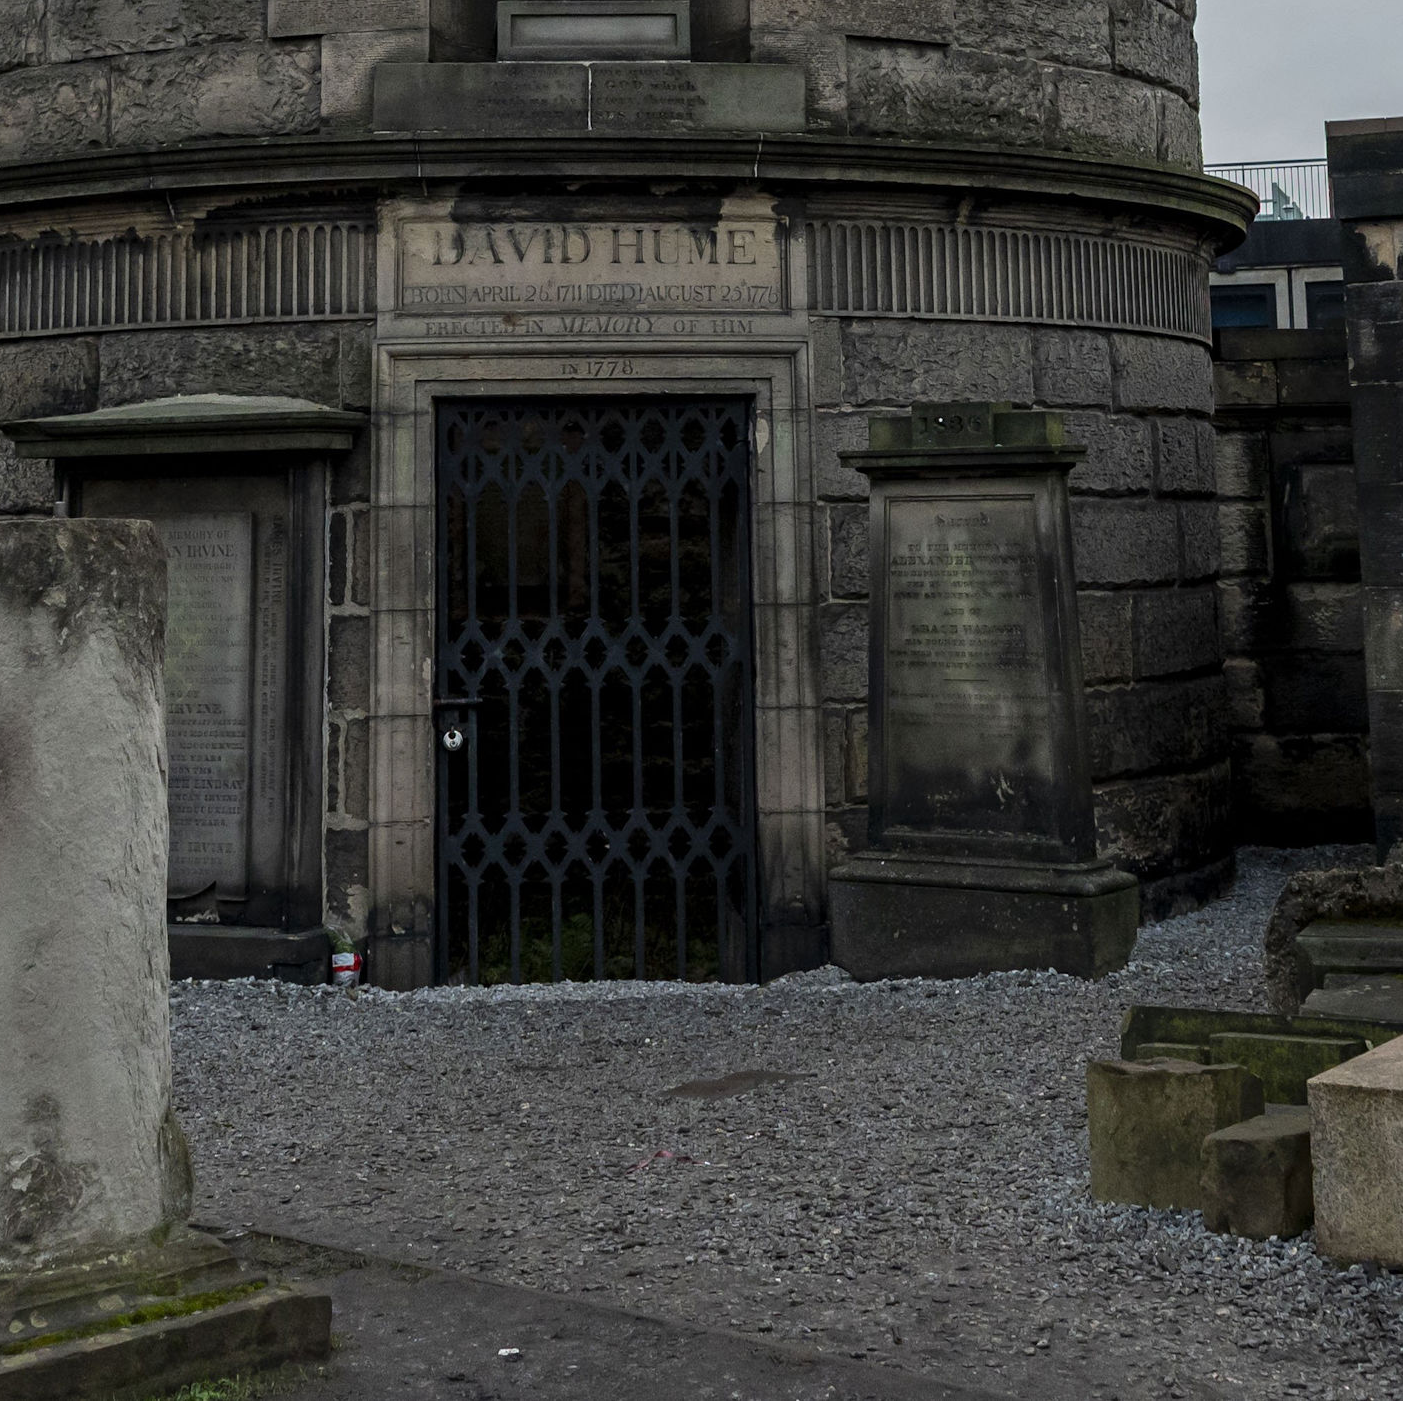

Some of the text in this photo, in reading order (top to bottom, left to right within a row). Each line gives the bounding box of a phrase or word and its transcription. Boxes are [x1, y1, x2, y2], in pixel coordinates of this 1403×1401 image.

[432, 224, 756, 265] DAVID HUME
[410, 286, 465, 303] BORN
[470, 286, 520, 302] APRIL
[558, 286, 582, 302] 1711
[587, 285, 637, 302] DIED
[646, 285, 716, 302] AUGUST
[748, 285, 778, 304] 1776
[425, 317, 754, 336] ERECTED IN MEMORY OF HIM
[561, 363, 579, 375] IN
